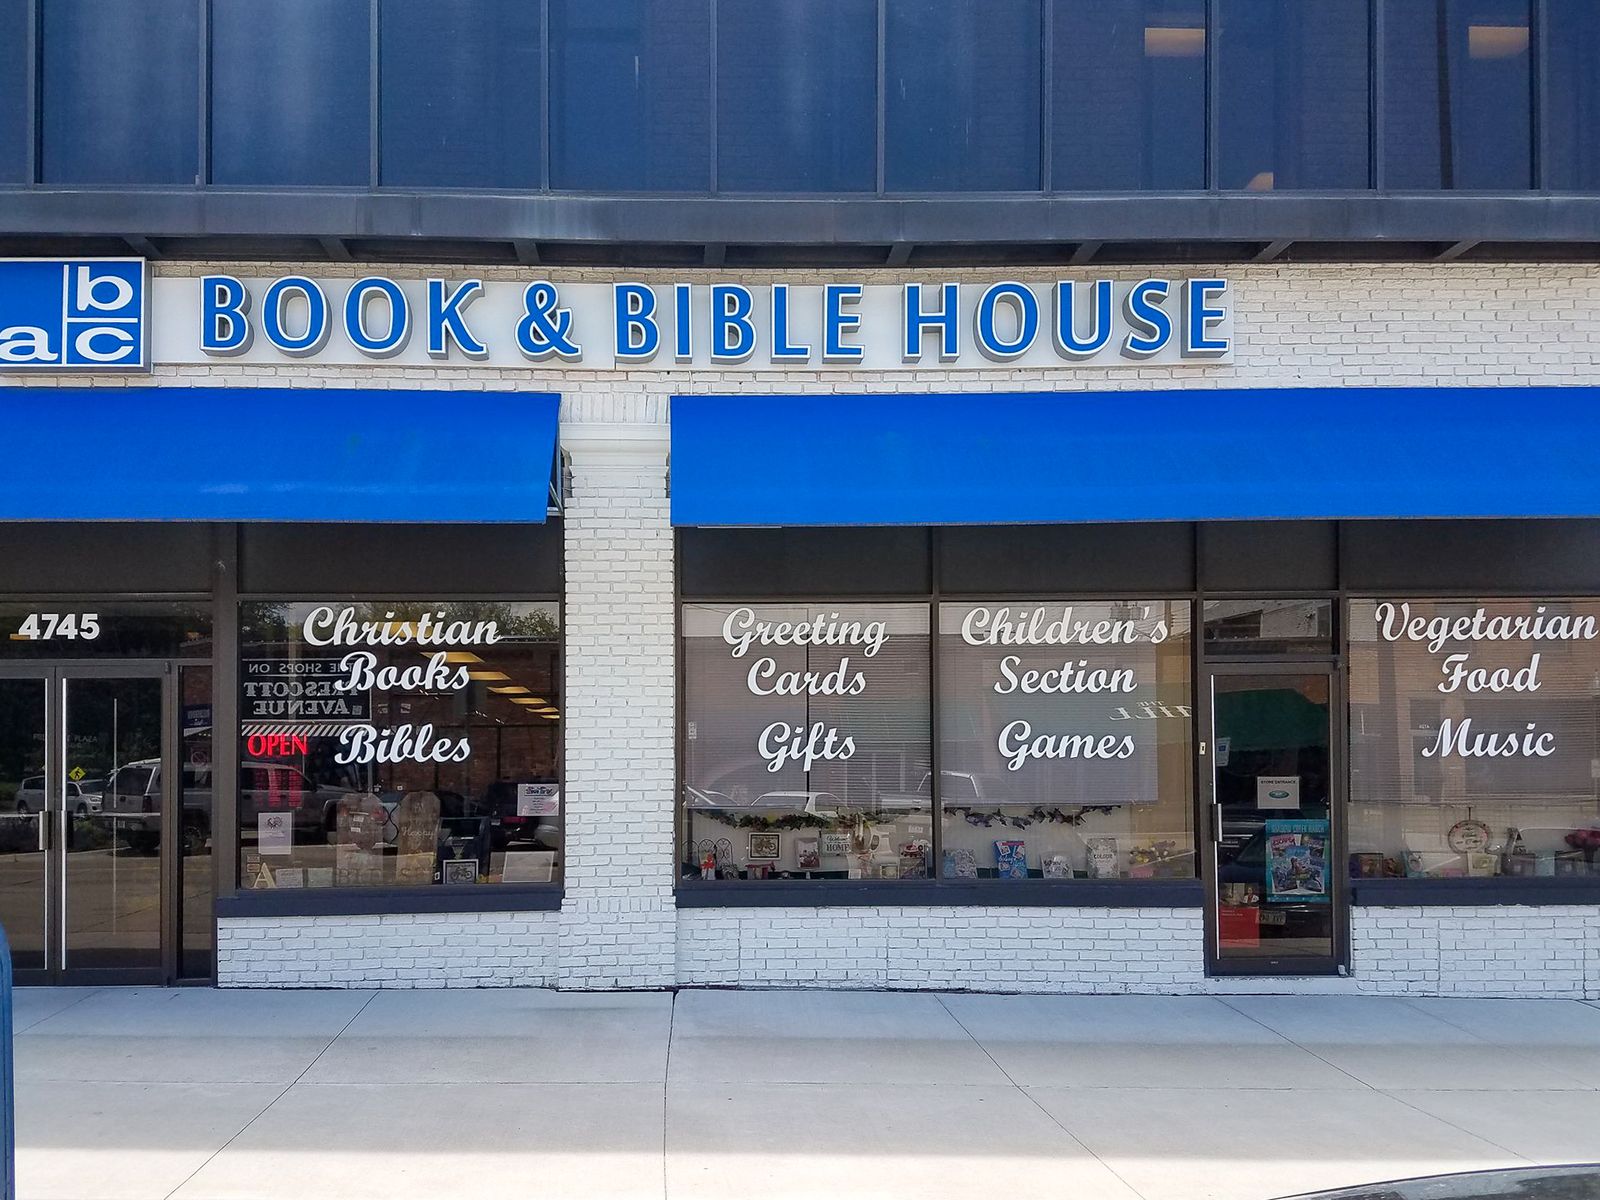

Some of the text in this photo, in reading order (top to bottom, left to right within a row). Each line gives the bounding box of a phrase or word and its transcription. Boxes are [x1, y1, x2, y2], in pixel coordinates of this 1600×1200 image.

[199, 275, 1230, 363] BOOK & BIBLE HOUSE
[18, 613, 100, 640] 4745
[302, 606, 502, 646] Christian
[722, 607, 890, 657] Greeting
[960, 606, 1168, 645] Children's
[1374, 601, 1599, 653] Vegetarian
[334, 650, 471, 692] Books
[747, 657, 866, 696] Cards
[993, 655, 1138, 694] Section
[1437, 653, 1542, 692] Food
[247, 733, 308, 756] OPEN
[334, 723, 471, 765] Bibles
[757, 721, 857, 773] Gifts
[998, 720, 1136, 771] Games
[1421, 718, 1557, 758] Music
